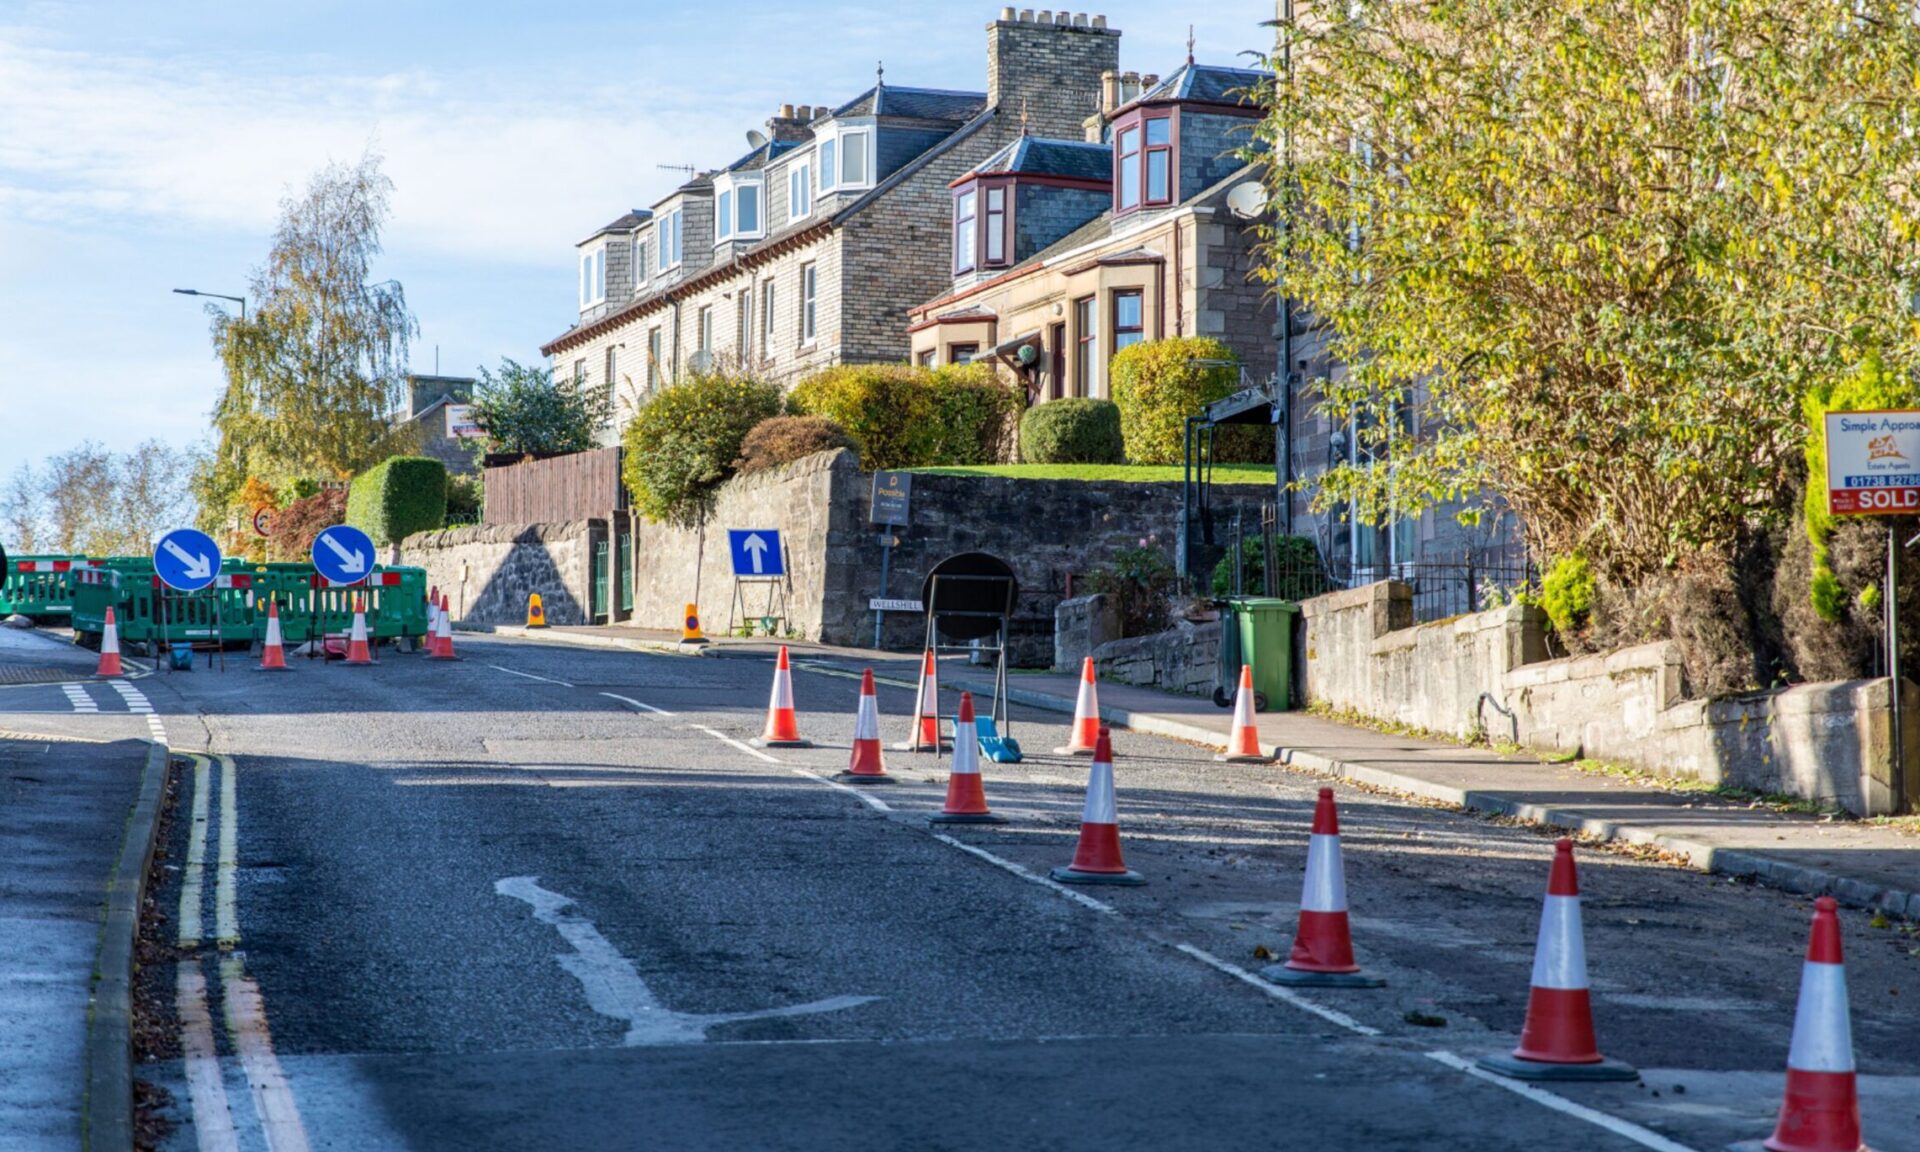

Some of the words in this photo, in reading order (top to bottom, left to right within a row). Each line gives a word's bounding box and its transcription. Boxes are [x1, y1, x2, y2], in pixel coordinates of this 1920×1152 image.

[1840, 418, 1877, 433] Simple
[1867, 462, 1886, 470] Estate
[1888, 461, 1911, 471] Agents
[1850, 477, 1886, 487] 01738
[1859, 489, 1918, 508] SOLD
[873, 600, 918, 610] WELLSHILL
